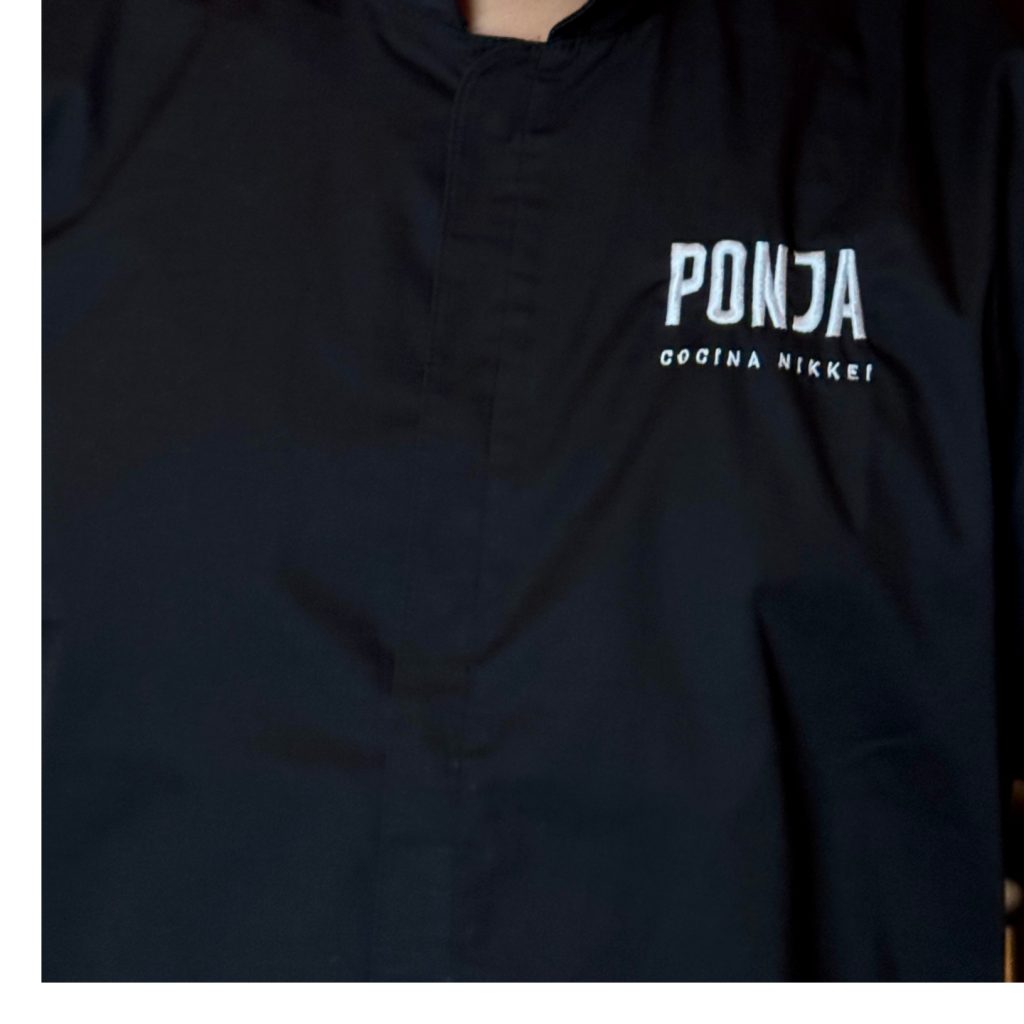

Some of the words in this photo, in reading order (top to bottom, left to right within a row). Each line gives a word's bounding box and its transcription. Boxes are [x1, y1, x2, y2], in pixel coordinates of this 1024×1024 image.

[665, 239, 867, 341] PONJA
[659, 347, 761, 370] COCINA
[777, 351, 873, 382] NIKKEI
